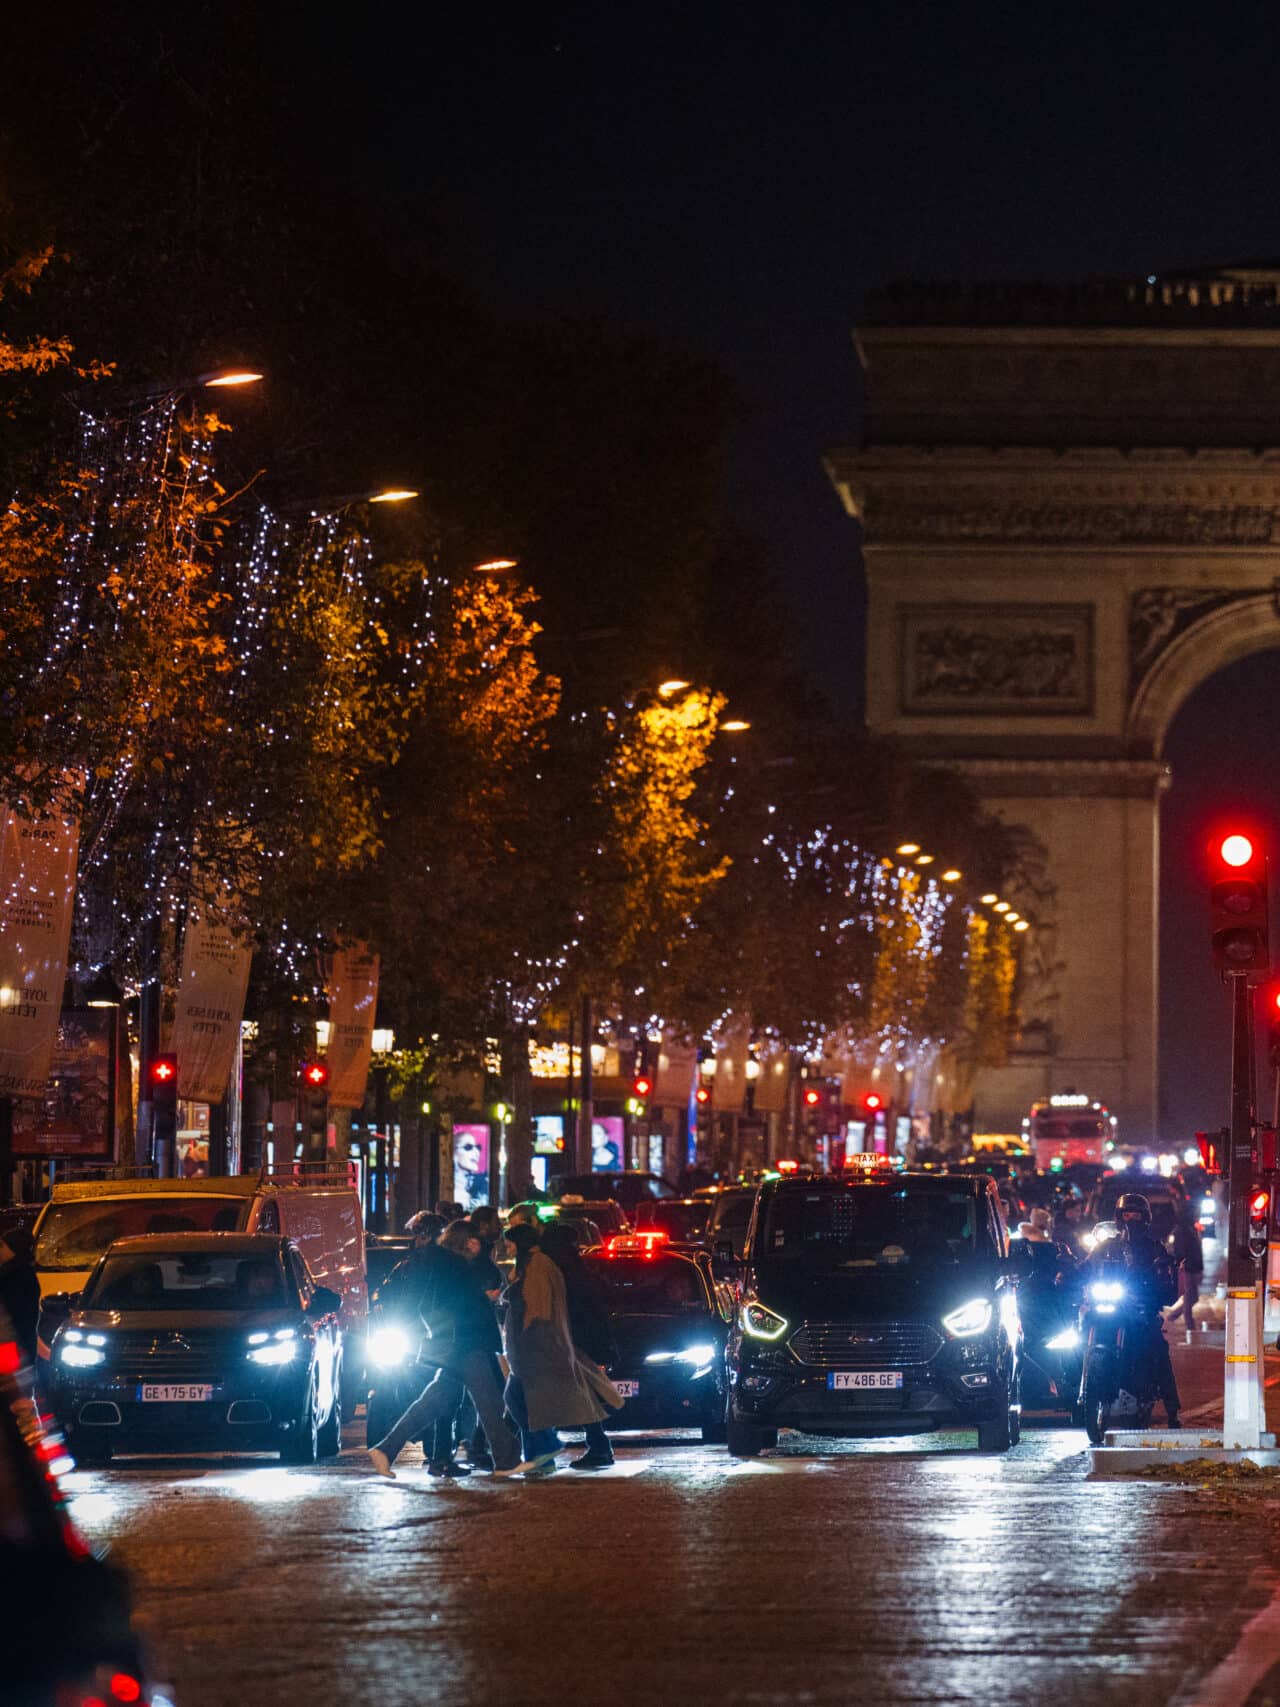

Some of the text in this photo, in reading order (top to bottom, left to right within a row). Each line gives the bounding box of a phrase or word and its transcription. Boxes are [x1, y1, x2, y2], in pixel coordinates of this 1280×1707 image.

[856, 1154, 877, 1162] TAXI
[836, 1374, 893, 1386] FY-486-GE
[145, 1387, 203, 1399] GE-175-GY
